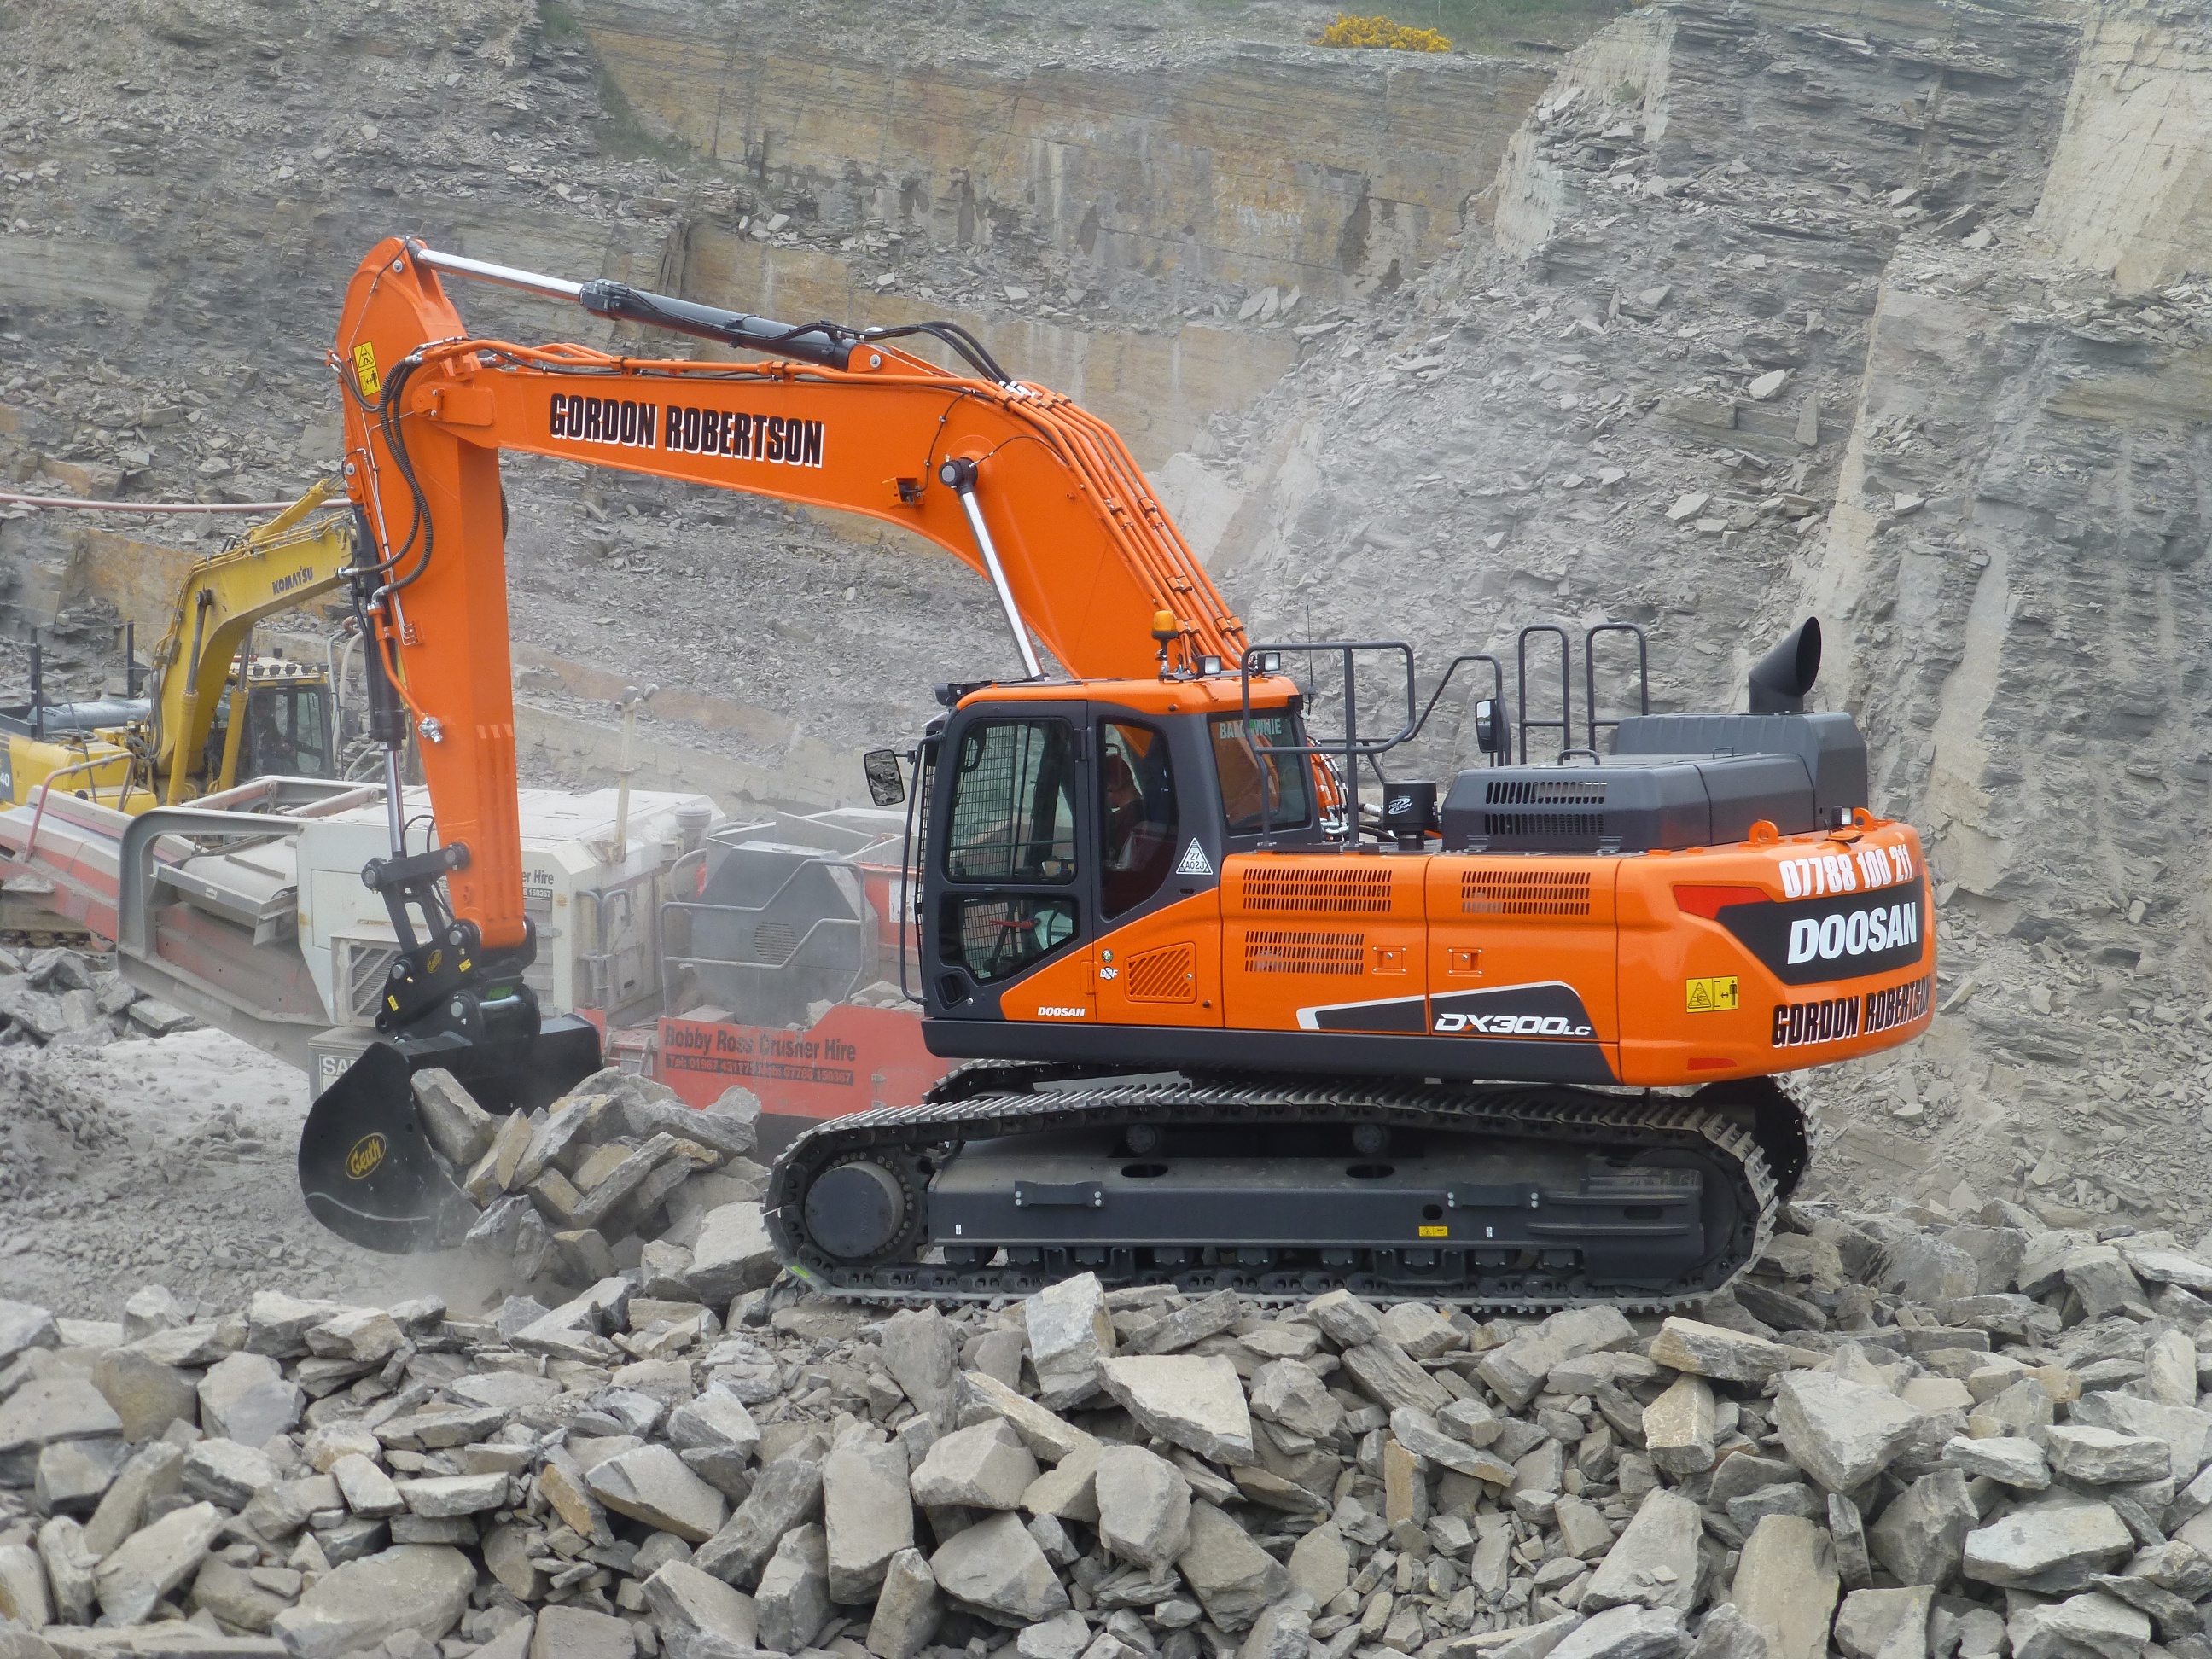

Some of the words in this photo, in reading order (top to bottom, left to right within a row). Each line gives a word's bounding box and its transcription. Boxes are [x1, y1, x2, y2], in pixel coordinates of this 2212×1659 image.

[549, 393, 658, 450] GORDON
[664, 405, 825, 469] ROBERTSON
[271, 566, 313, 595] KOMATSU
[533, 869, 554, 885] Hire
[1778, 854, 1856, 899] 07788
[1856, 848, 1891, 889] 100
[1889, 843, 1914, 883] 211
[1787, 901, 1918, 965] DOOSAN
[1037, 1006, 1086, 1017] DOOSAN
[1771, 995, 1861, 1049] GORDON
[1864, 973, 1932, 1035] ROBERTSON
[665, 1024, 713, 1057] Bobby
[716, 1029, 754, 1054] Ross
[759, 1033, 820, 1059] Crusher
[824, 1038, 857, 1062] Hire
